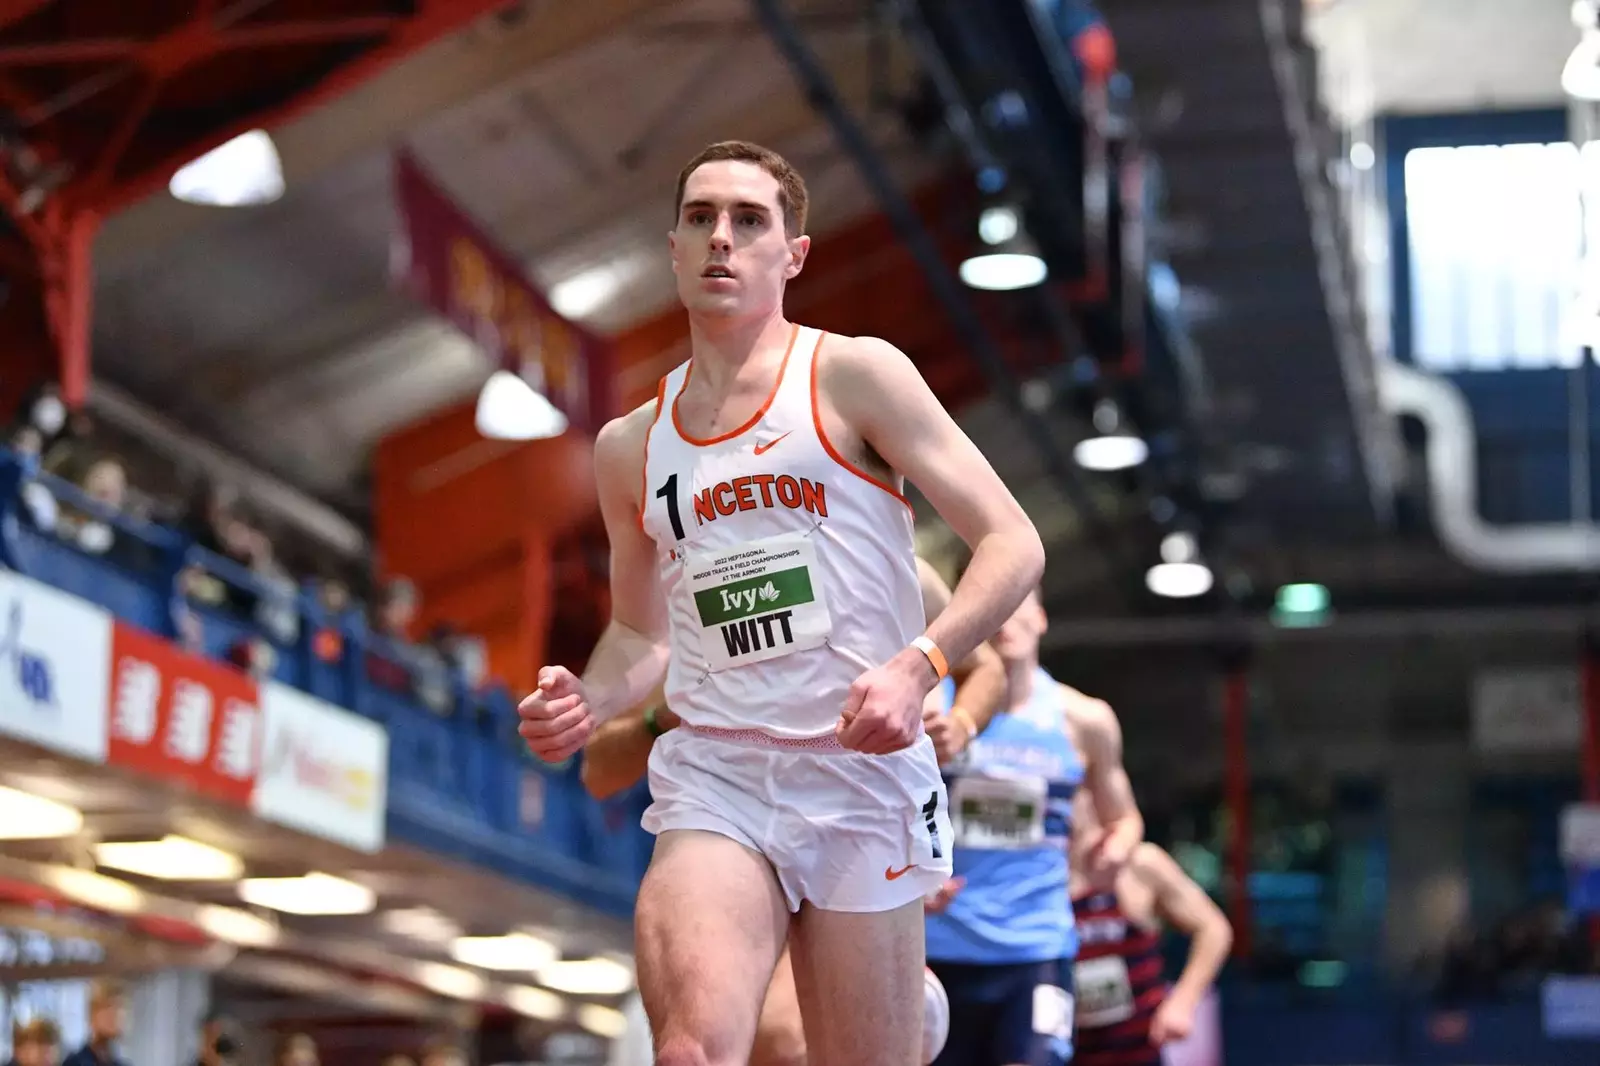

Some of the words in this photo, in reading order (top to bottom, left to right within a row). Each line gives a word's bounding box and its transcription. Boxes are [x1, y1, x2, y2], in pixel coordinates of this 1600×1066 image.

[656, 473, 686, 541] 1
[693, 571, 711, 580] INDOOR
[711, 567, 730, 576] TRACK
[735, 561, 751, 570] FIELD
[751, 549, 800, 566] CHAMPIONSHIPS
[714, 557, 727, 566] 2022
[728, 548, 766, 562] HEPTAGONAL
[722, 574, 730, 582] AT
[730, 572, 741, 580] THE
[742, 566, 766, 577] ARMORY
[720, 587, 757, 612] Ivy
[721, 610, 794, 657] WITT
